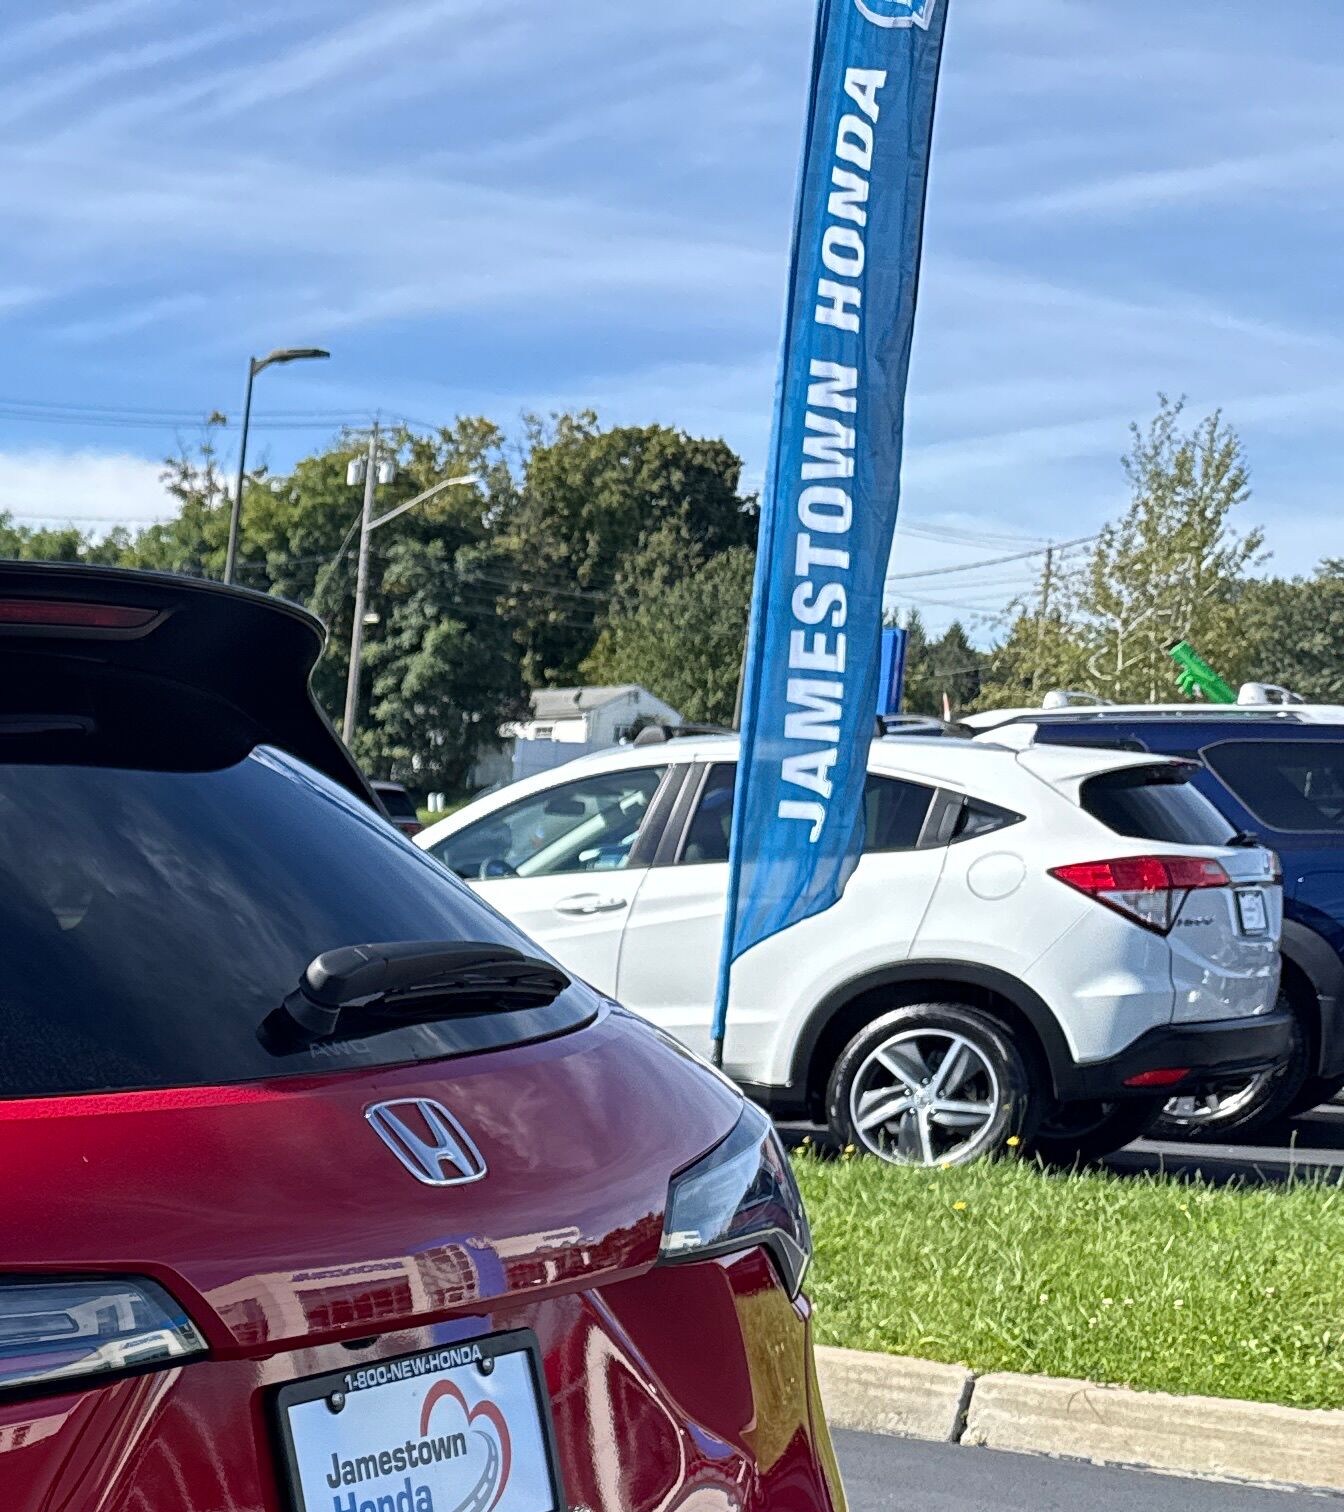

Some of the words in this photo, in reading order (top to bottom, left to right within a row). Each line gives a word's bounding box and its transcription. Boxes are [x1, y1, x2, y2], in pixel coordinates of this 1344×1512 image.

[815, 67, 888, 334] HONDA
[777, 358, 858, 843] JAMESTOWN
[343, 1344, 483, 1392] 1-800-NEW-HONDA
[326, 1430, 468, 1489] Jamestown
